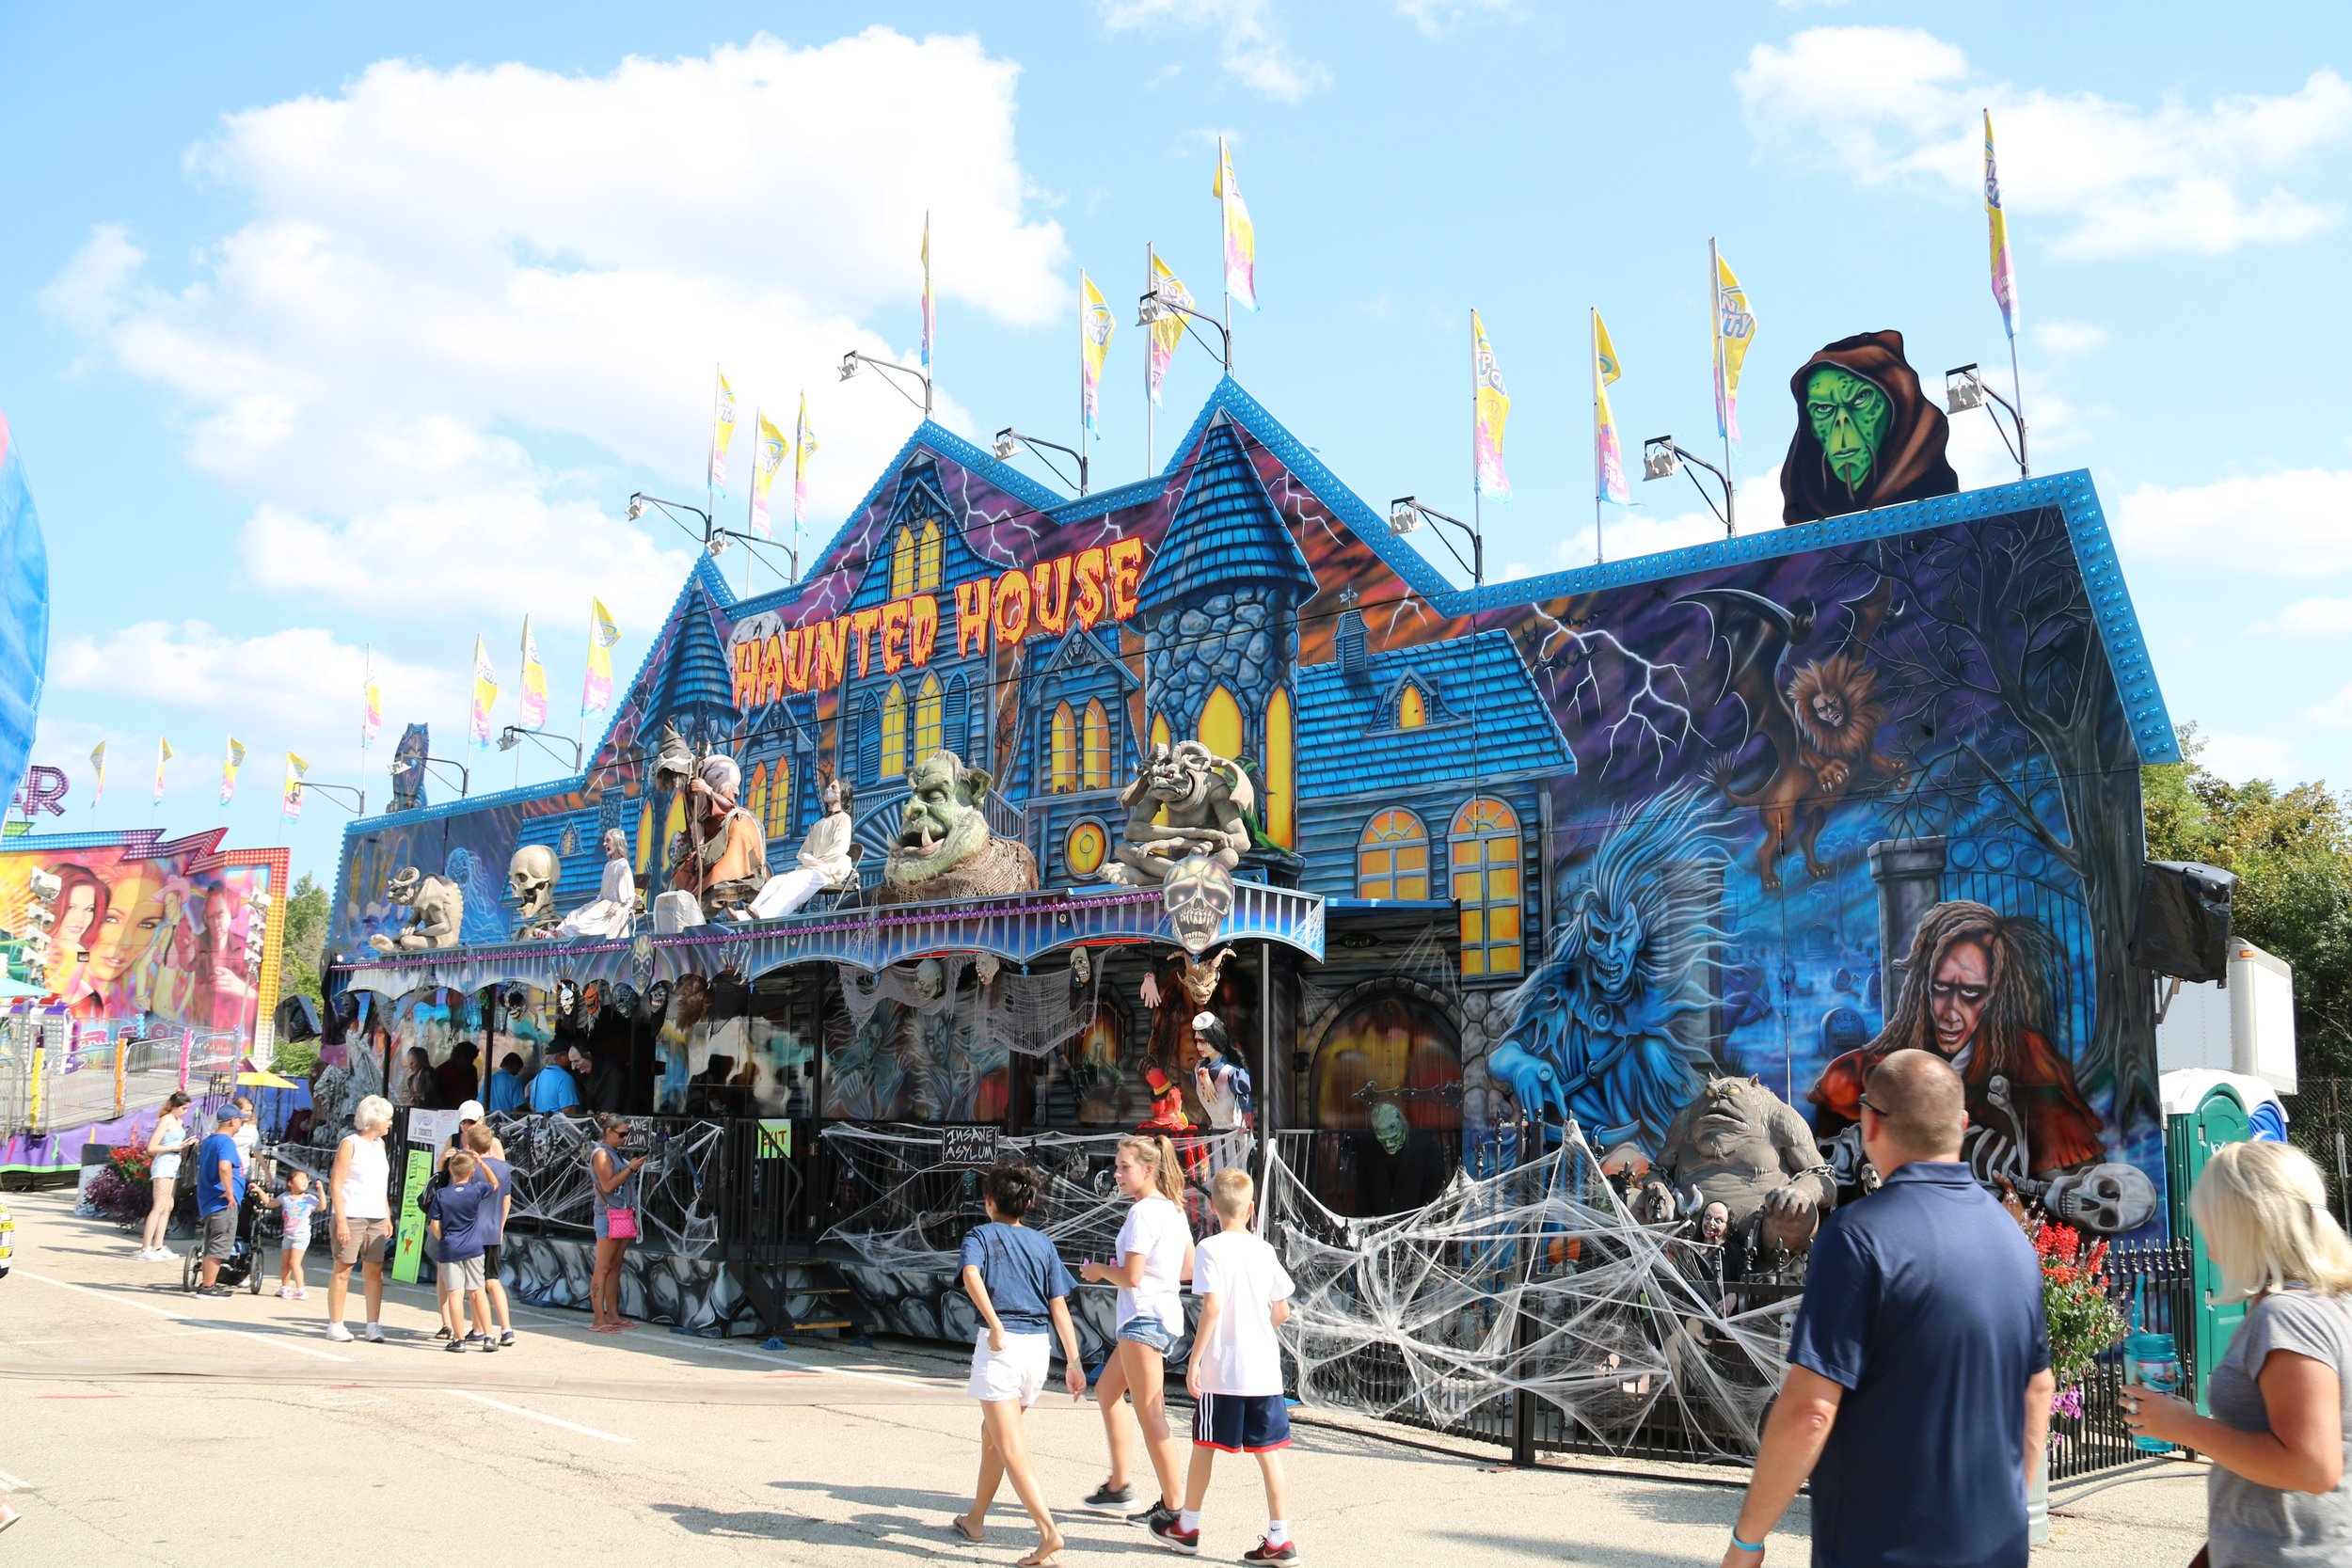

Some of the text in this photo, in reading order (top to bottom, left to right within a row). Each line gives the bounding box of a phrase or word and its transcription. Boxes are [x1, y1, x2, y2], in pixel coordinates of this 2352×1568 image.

[731, 536, 1145, 710] HAUNTED HOUSE
[628, 1118, 648, 1132] ANE
[624, 1132, 646, 1147] YLUM
[946, 1128, 993, 1145] INSANE
[946, 1144, 994, 1161] ASYLUM
